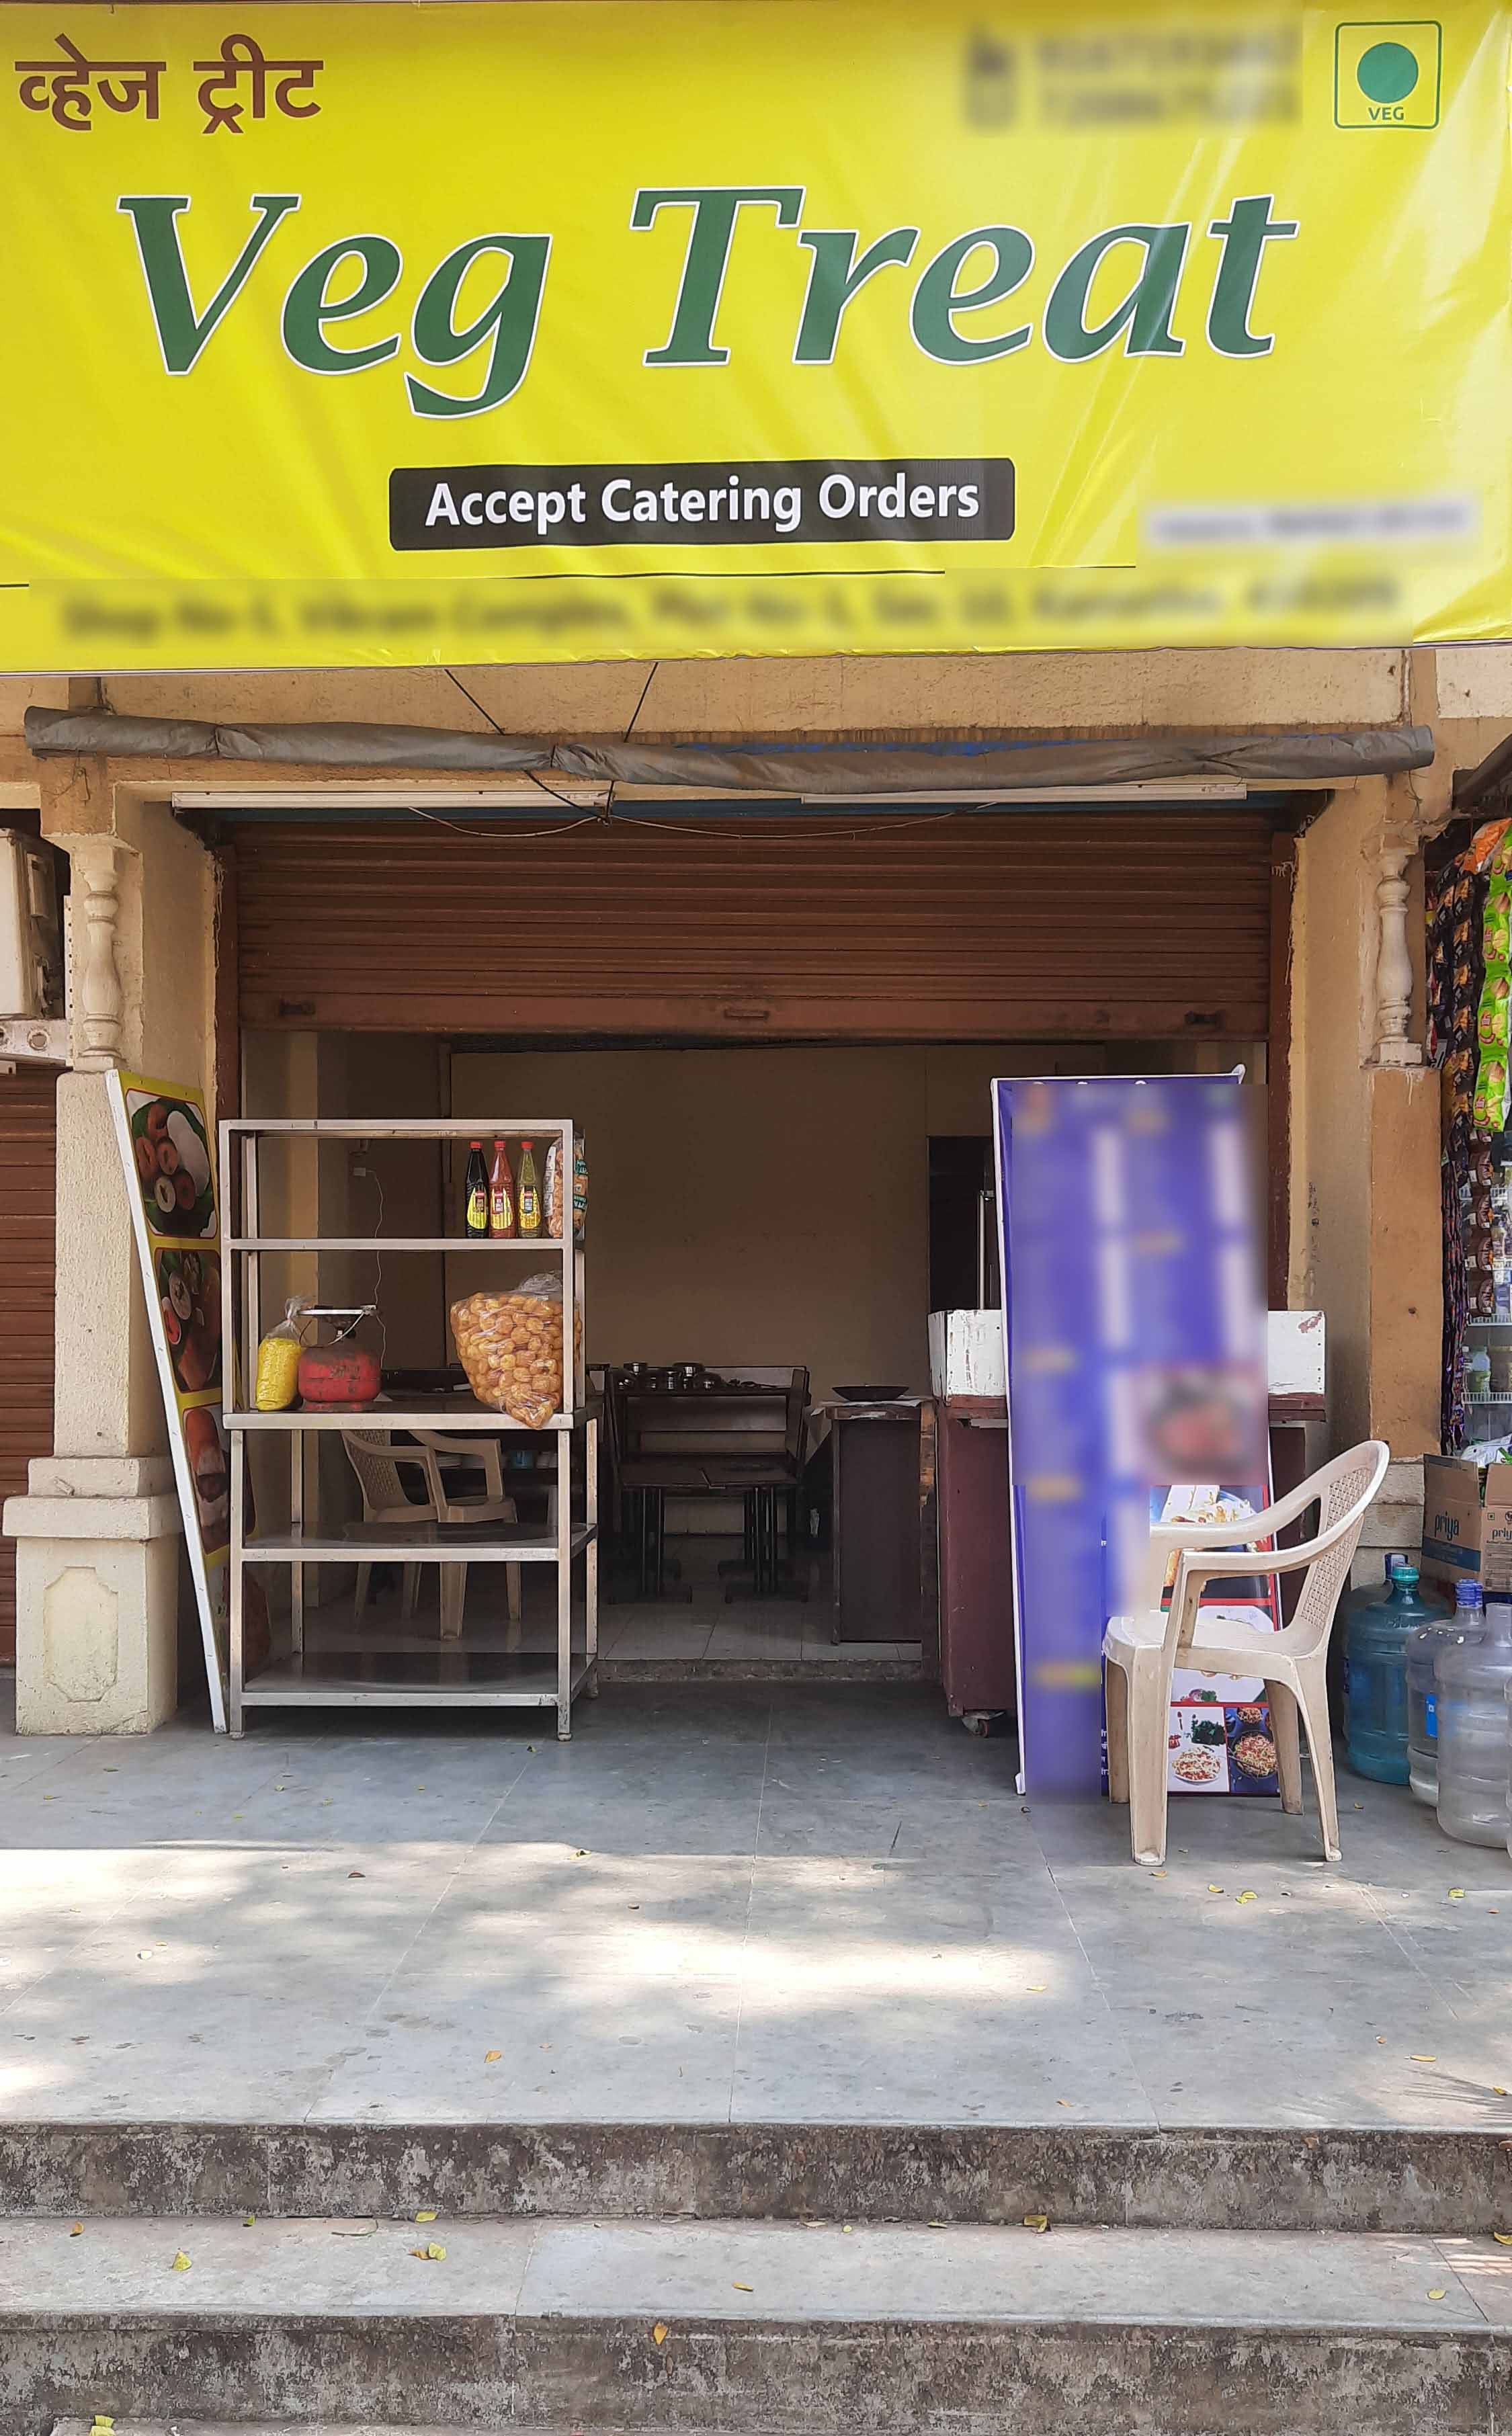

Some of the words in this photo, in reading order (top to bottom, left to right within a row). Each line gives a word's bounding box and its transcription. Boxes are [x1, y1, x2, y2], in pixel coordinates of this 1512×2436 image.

[15, 33, 167, 130] व्हेज
[194, 34, 324, 133] ट्रीट
[1369, 107, 1404, 120] VEG
[120, 195, 551, 418] Veg
[633, 188, 1298, 364] Treat
[425, 482, 585, 535] Accept
[601, 478, 800, 532] Catering
[819, 472, 979, 519] Orders
[1435, 1511, 1459, 1541] priya
[1493, 1527, 1512, 1541] priy
